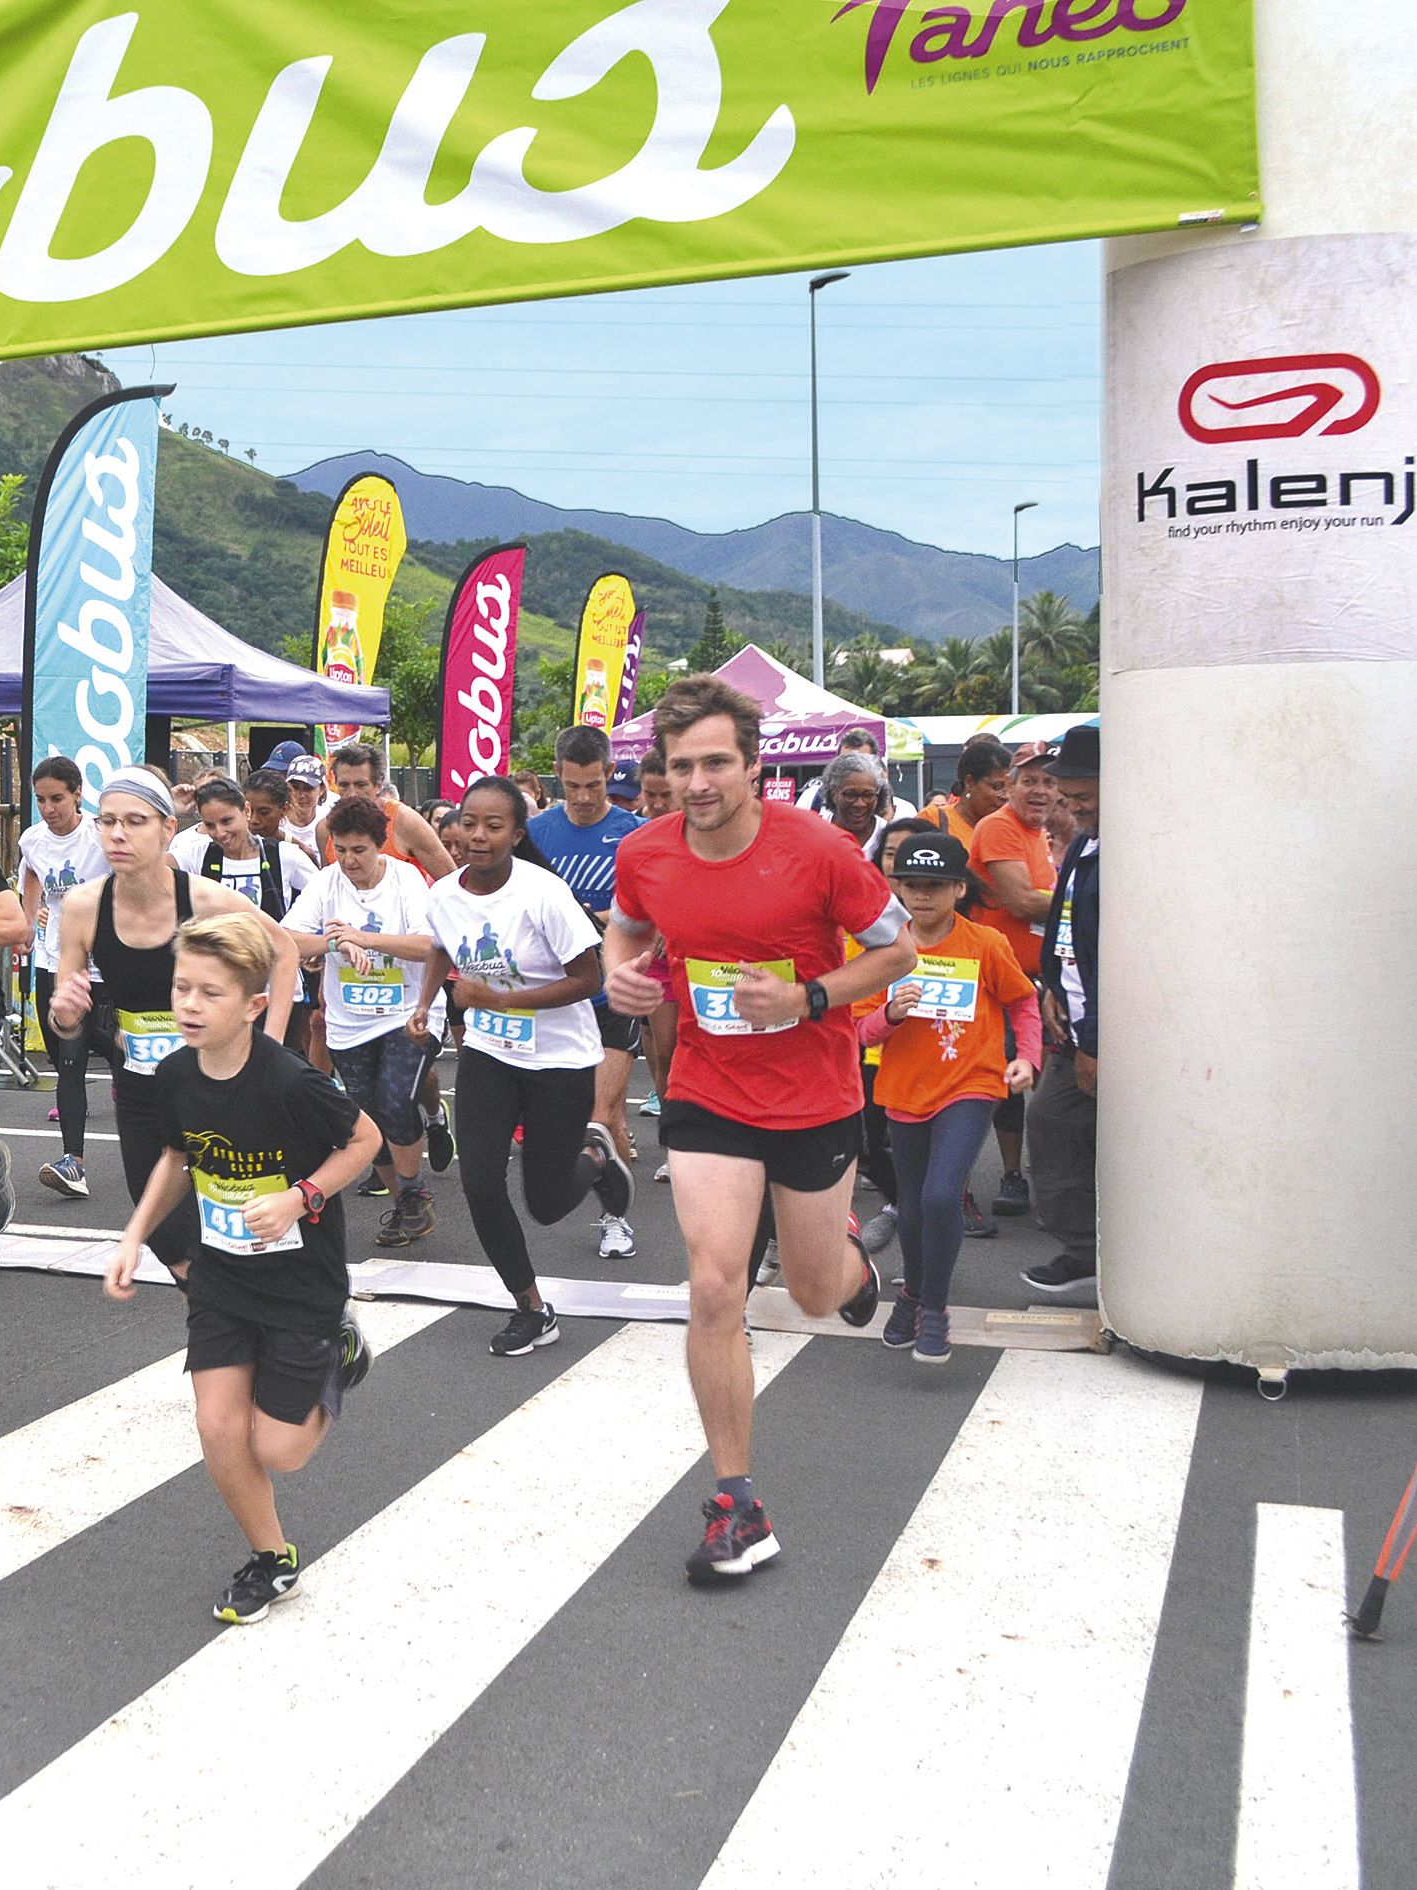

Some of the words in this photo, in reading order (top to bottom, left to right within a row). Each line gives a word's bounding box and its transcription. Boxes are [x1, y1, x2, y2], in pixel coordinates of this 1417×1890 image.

[910, 75, 935, 90] LES
[941, 67, 991, 85] LIGNES
[1027, 55, 1071, 71] NOUS
[1076, 37, 1190, 65] RAPPROCHENT
[1168, 524, 1190, 539] find
[1193, 523, 1223, 539] your
[1225, 519, 1277, 536] rhythm
[1280, 516, 1321, 532] enjoy
[1323, 516, 1357, 531] your
[1360, 516, 1384, 527] run
[342, 541, 371, 557] TOUT
[766, 788, 791, 800] SANS
[349, 986, 394, 1004] 302
[477, 1010, 523, 1039] 315
